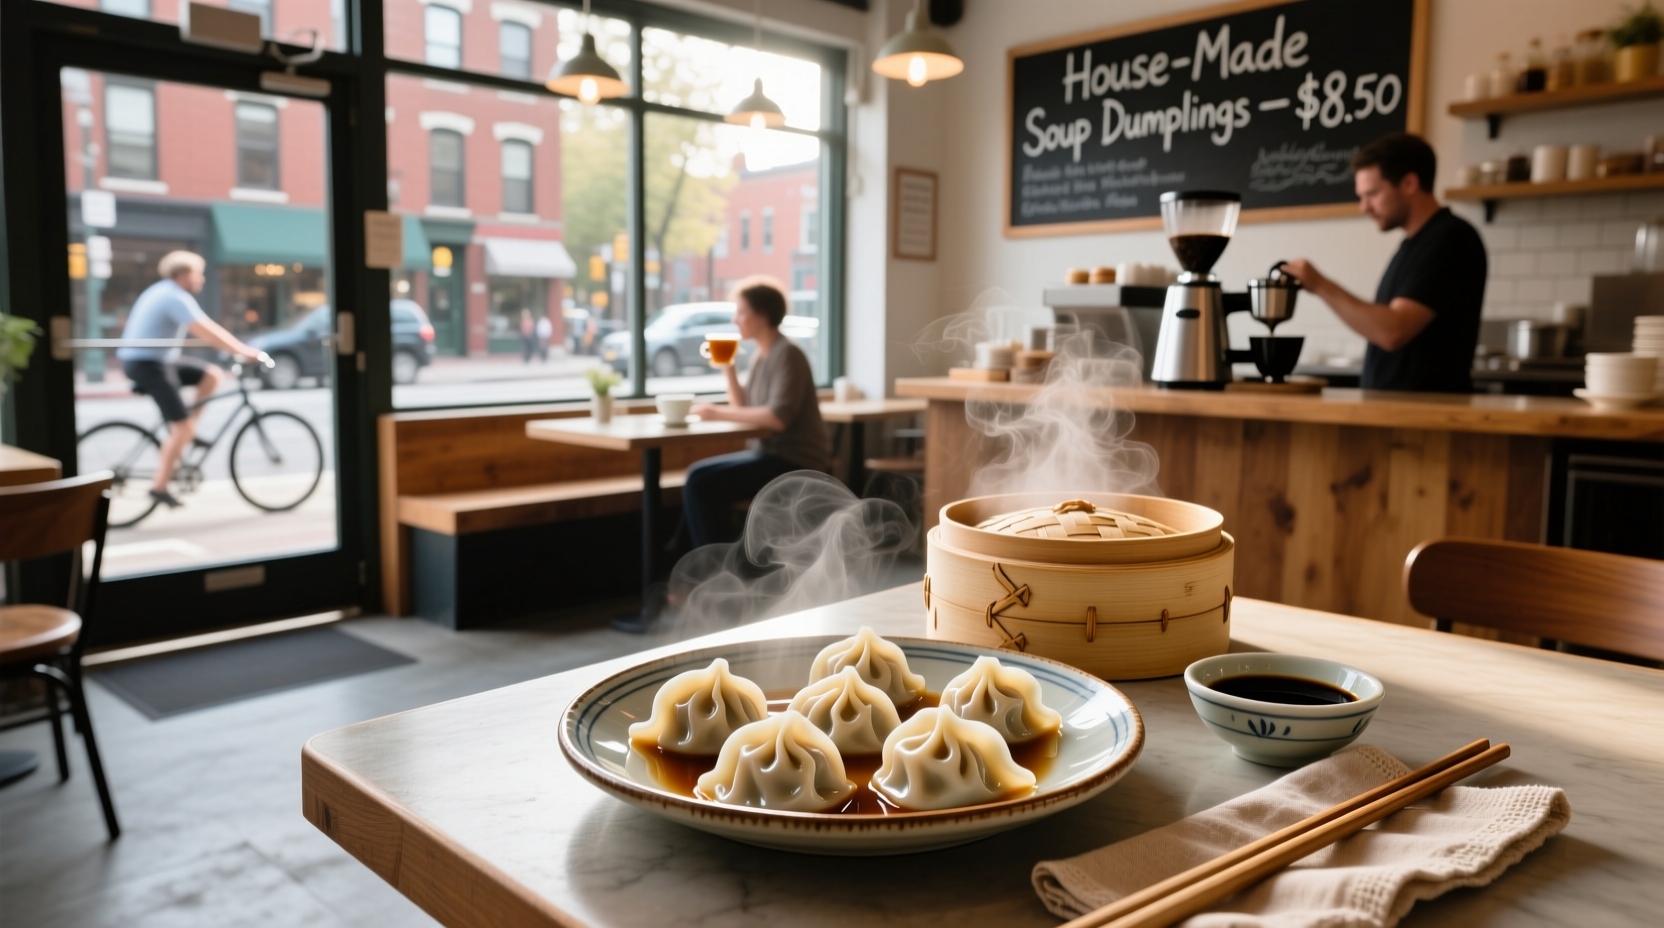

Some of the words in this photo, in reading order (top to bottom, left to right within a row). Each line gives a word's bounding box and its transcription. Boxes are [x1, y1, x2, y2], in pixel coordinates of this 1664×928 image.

[1062, 14, 1309, 104] House-Made
[1022, 106, 1092, 163] Soup
[1101, 90, 1251, 153] Dumplings
[1294, 71, 1402, 131] $8.50
